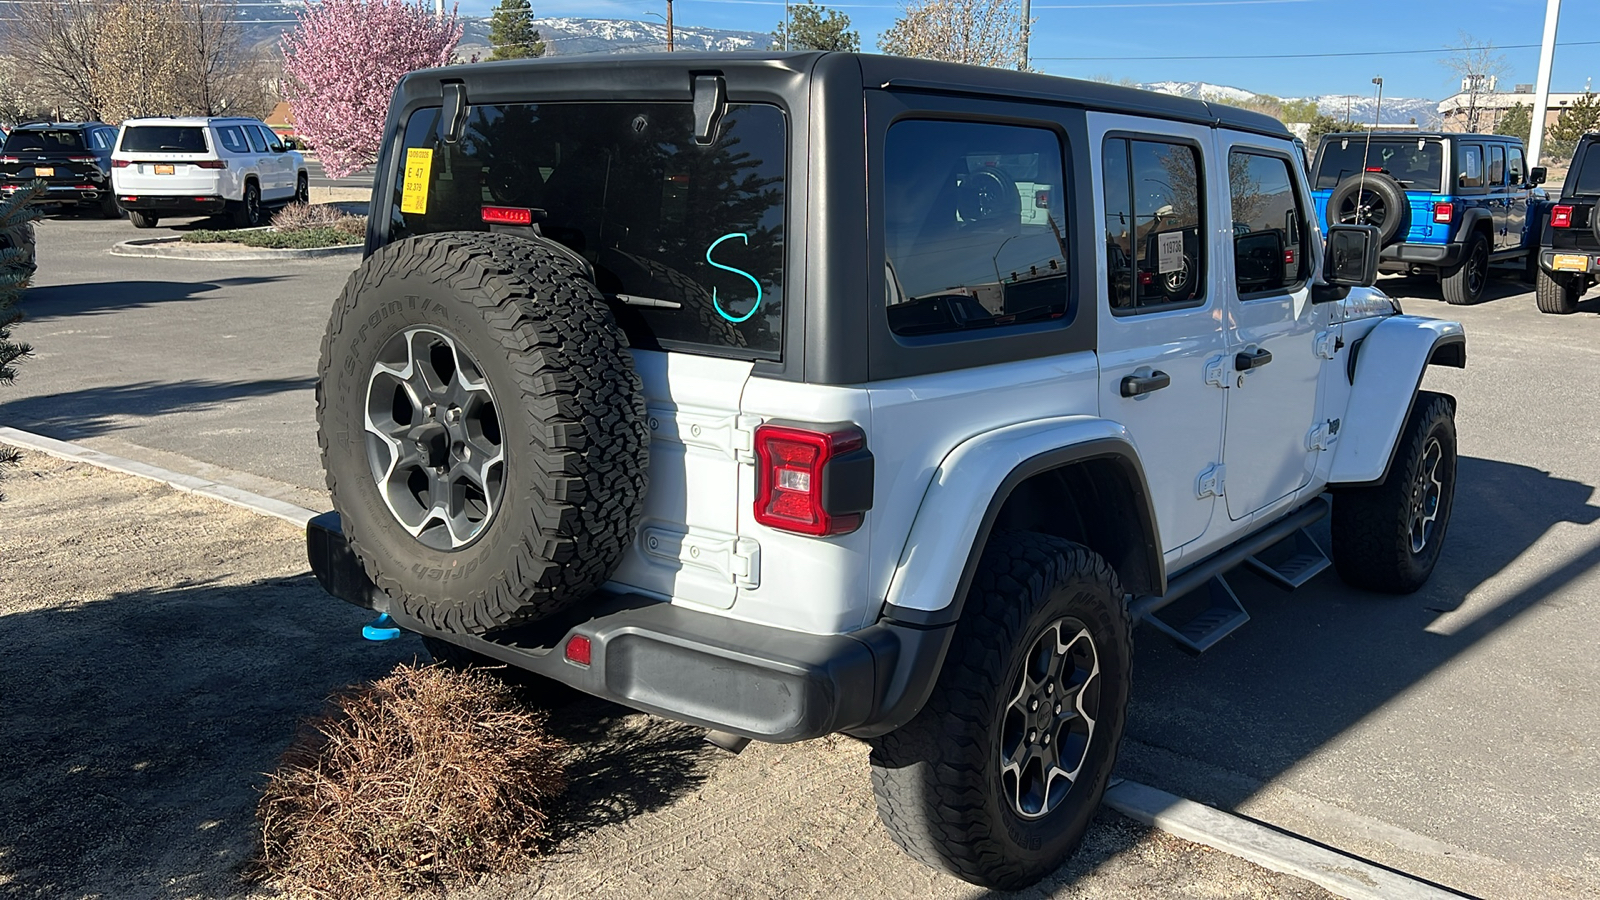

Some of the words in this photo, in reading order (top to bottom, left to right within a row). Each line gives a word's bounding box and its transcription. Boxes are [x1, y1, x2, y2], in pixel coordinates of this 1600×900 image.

[408, 167, 413, 178] E
[415, 168, 424, 179] 47
[1163, 240, 1182, 255] 119736
[706, 232, 762, 322] S
